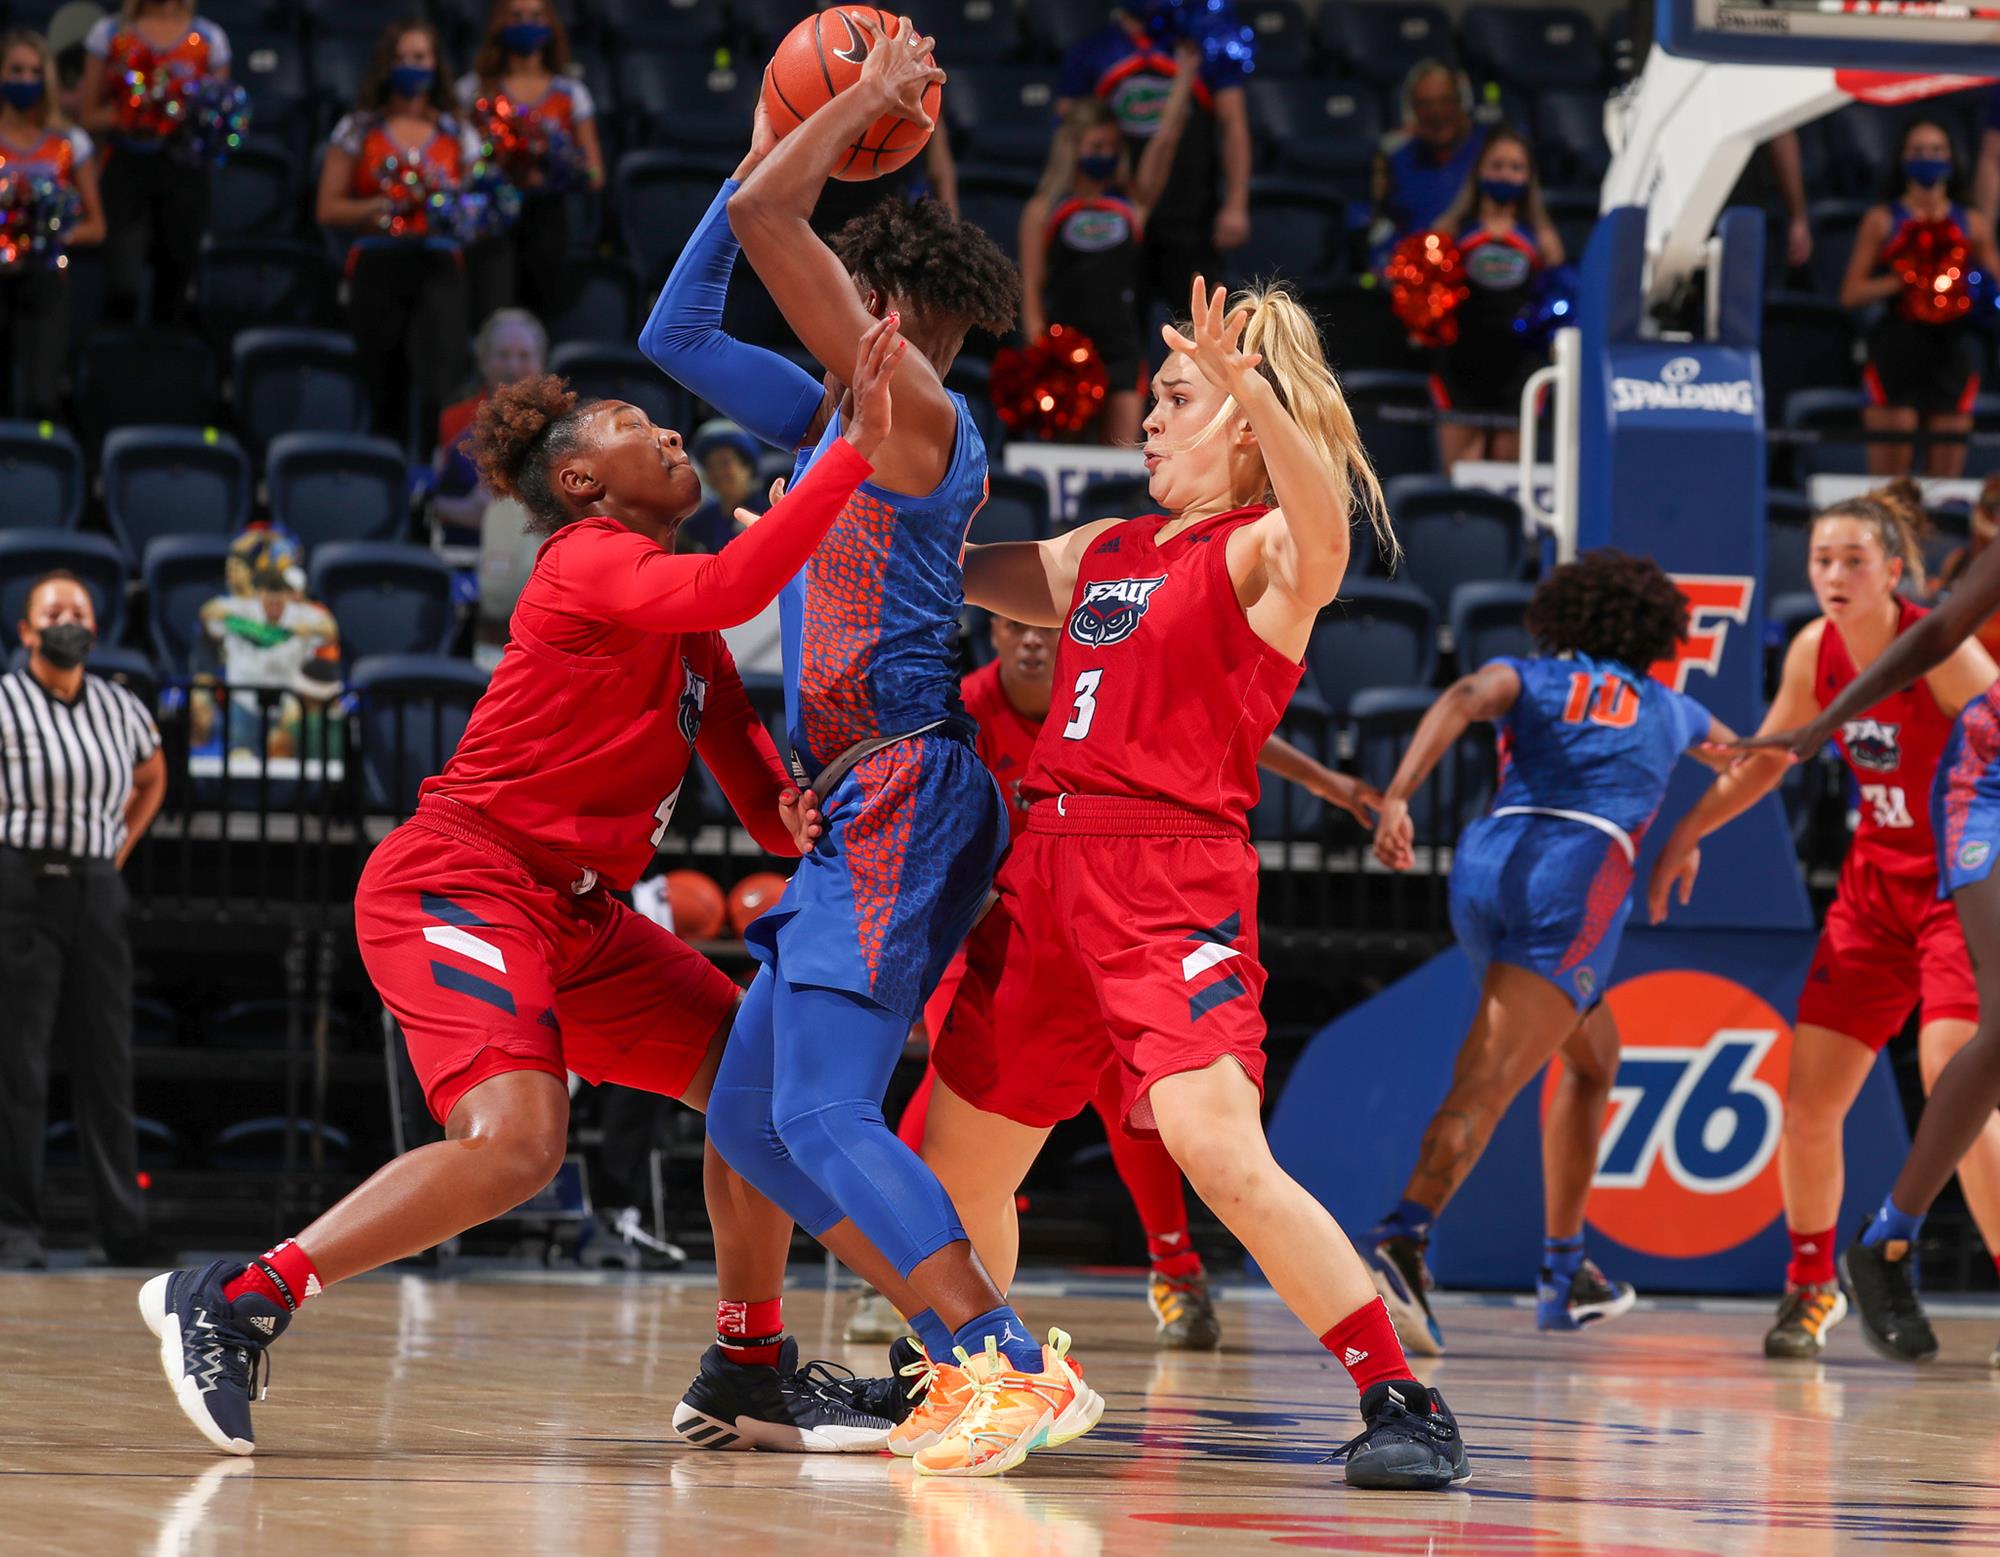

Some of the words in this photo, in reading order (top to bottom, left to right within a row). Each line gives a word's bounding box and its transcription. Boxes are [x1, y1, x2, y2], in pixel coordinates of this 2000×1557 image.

[1610, 377, 1754, 416] SPALDING
[1083, 573, 1168, 606] FAU
[1062, 667, 1104, 741] 3
[1562, 670, 1640, 729] 10
[650, 776, 684, 848] 4
[1592, 1028, 1784, 1195] 76
[249, 1316, 274, 1336] adidas
